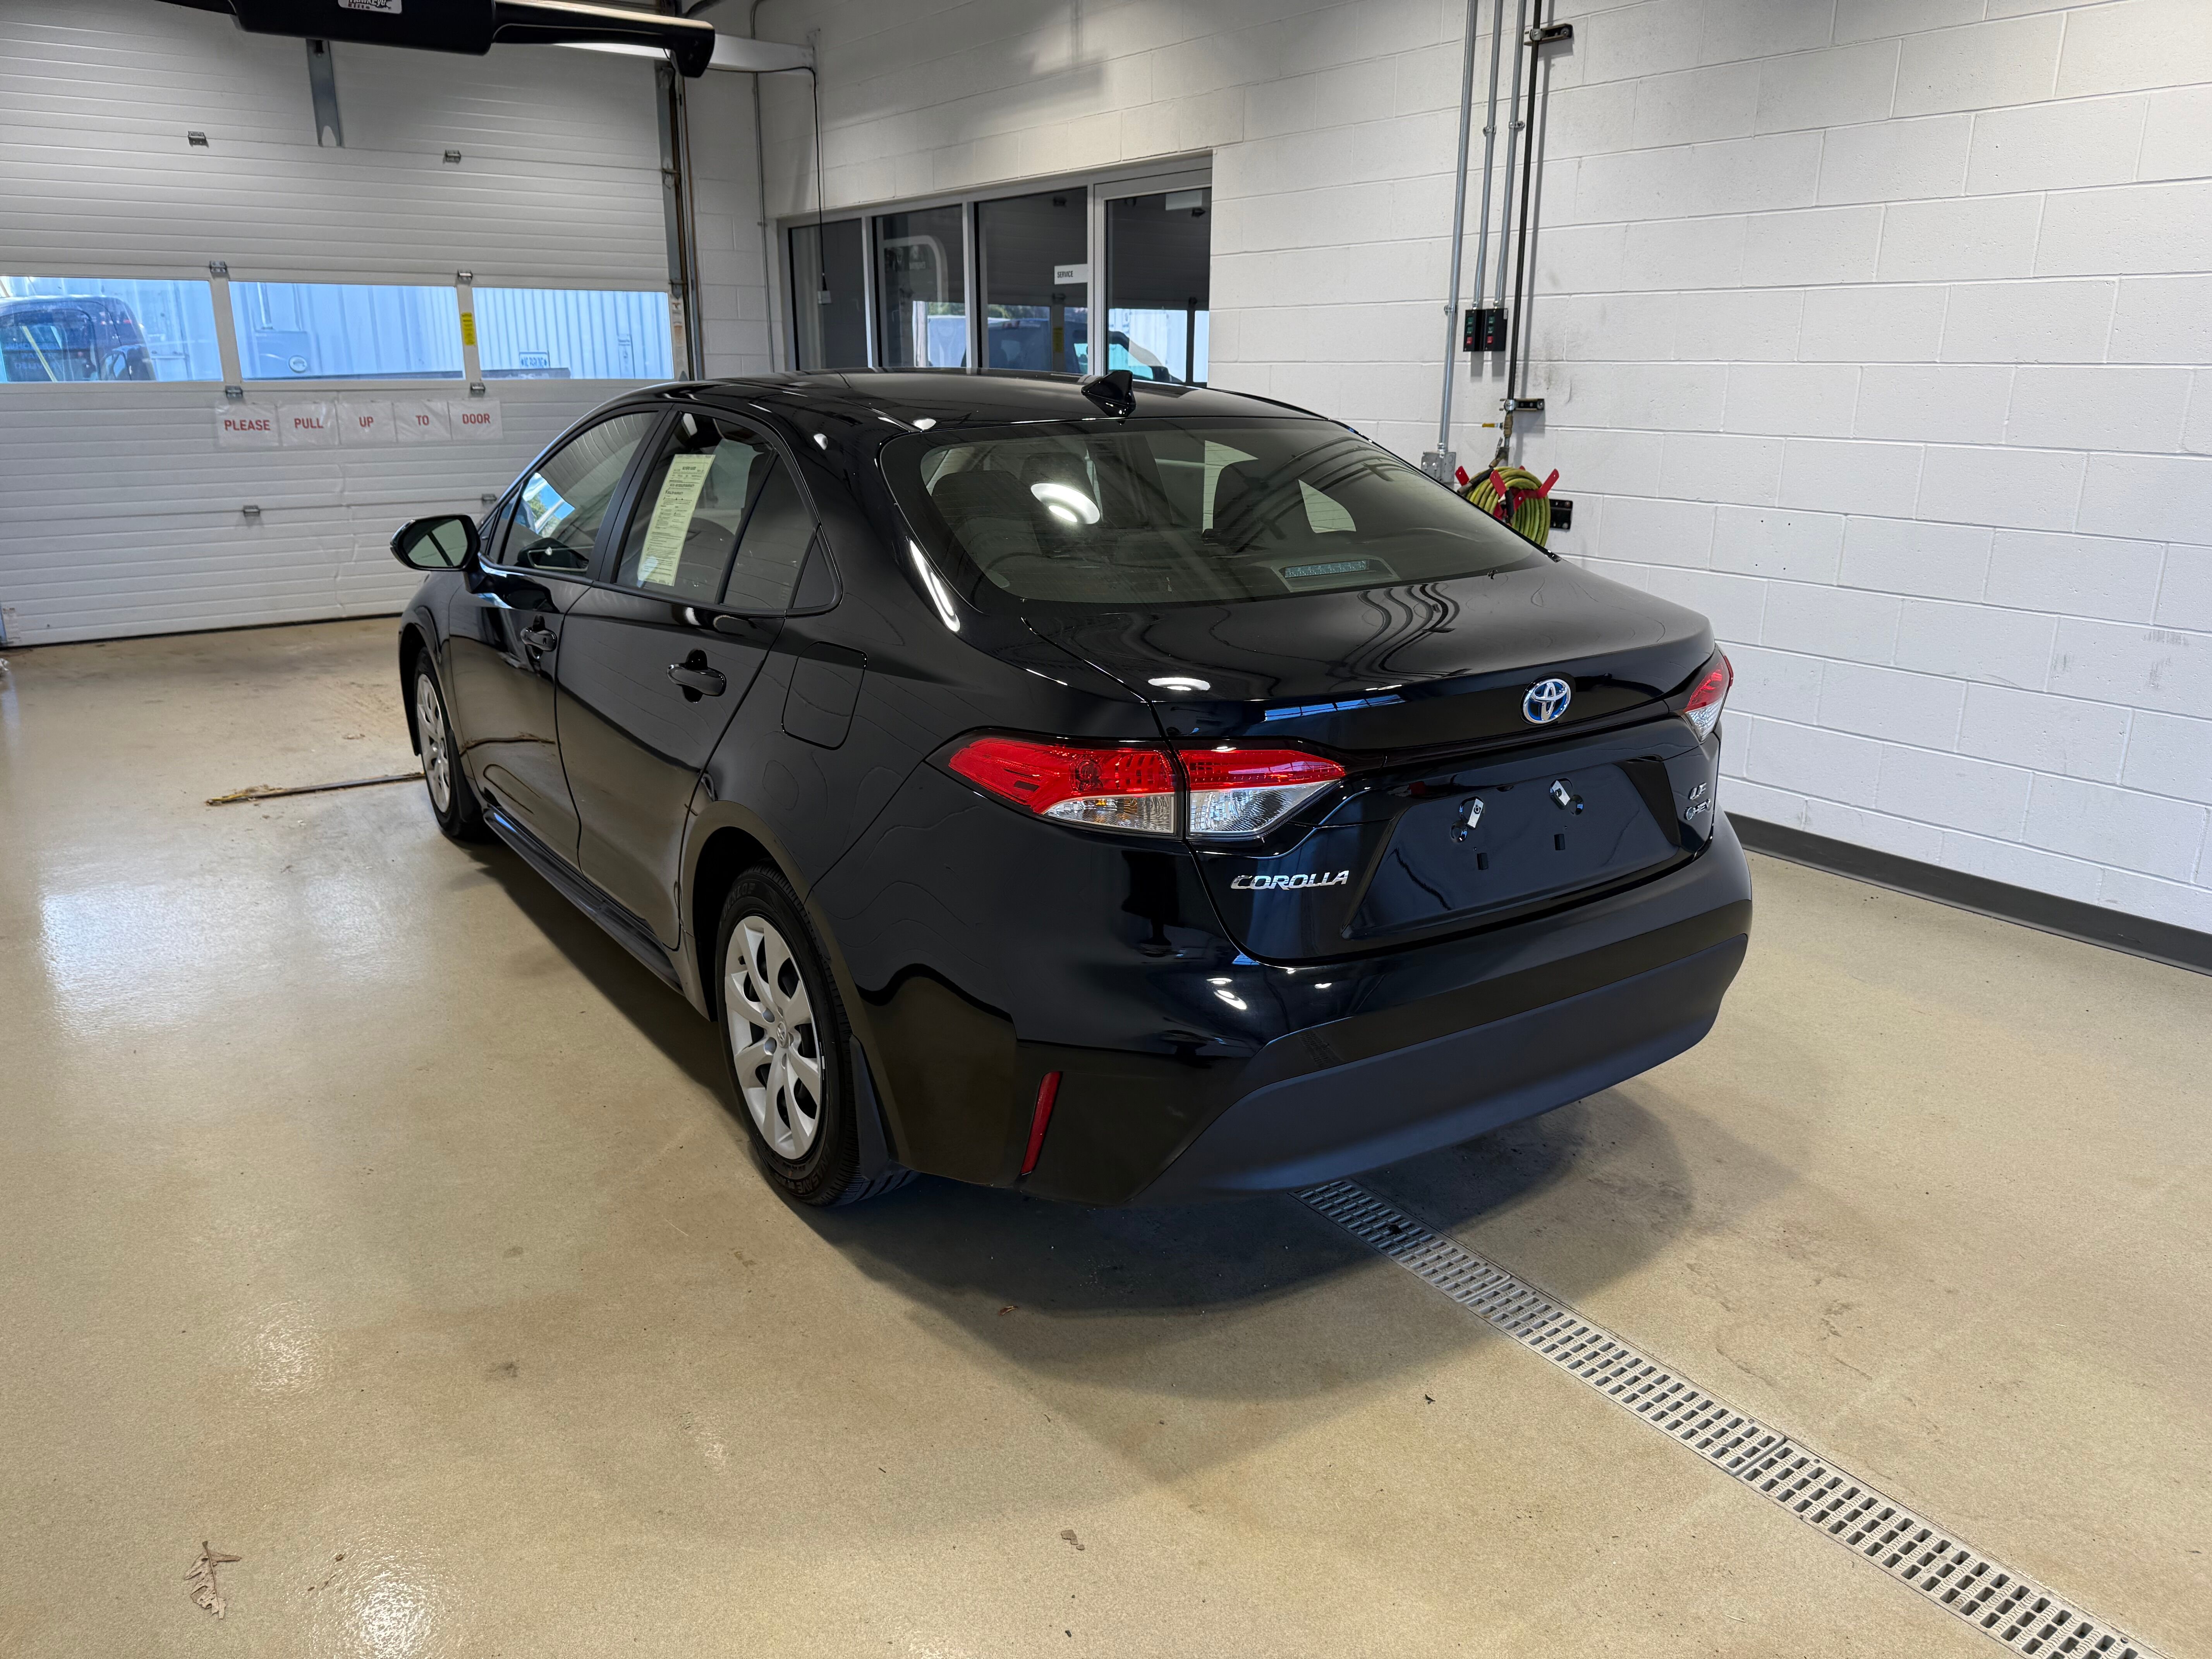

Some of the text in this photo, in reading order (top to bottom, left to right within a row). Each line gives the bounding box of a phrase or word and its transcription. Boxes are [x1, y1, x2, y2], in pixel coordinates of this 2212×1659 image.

[224, 413, 491, 431] PLEASE PULL UP TO DOOR
[1688, 782, 1707, 800] LE
[1231, 870, 1349, 890] COROLLA
